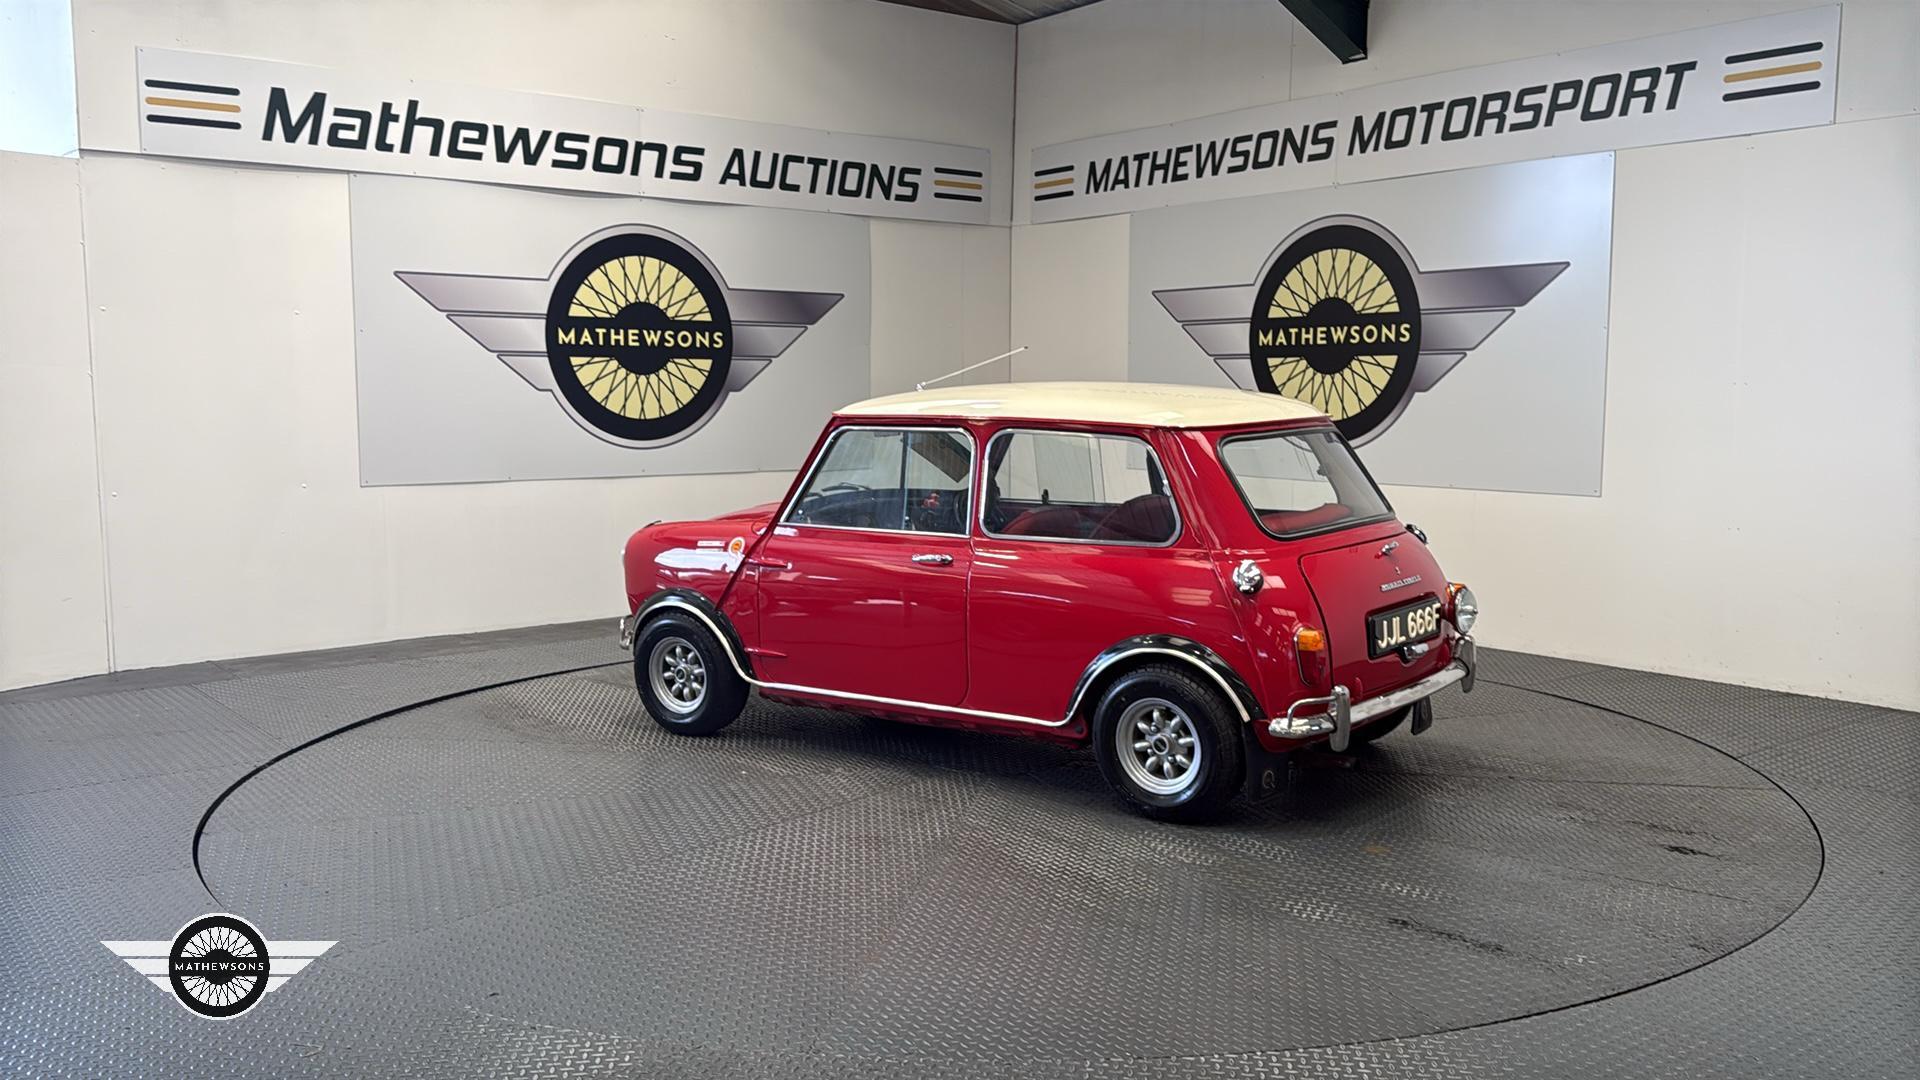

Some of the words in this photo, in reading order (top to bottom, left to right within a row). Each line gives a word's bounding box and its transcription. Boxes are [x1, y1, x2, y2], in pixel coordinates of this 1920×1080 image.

[262, 87, 705, 181] Mathewsons
[719, 148, 922, 202] AUCTIONS
[1085, 121, 1338, 195] MATHEWSONS
[1347, 61, 1697, 156] MOTORSPORT
[557, 327, 724, 349] MATHEWSONS
[1259, 323, 1411, 346] MATHEWSONS
[1378, 616, 1406, 648] JJL
[1408, 603, 1441, 638] 666F
